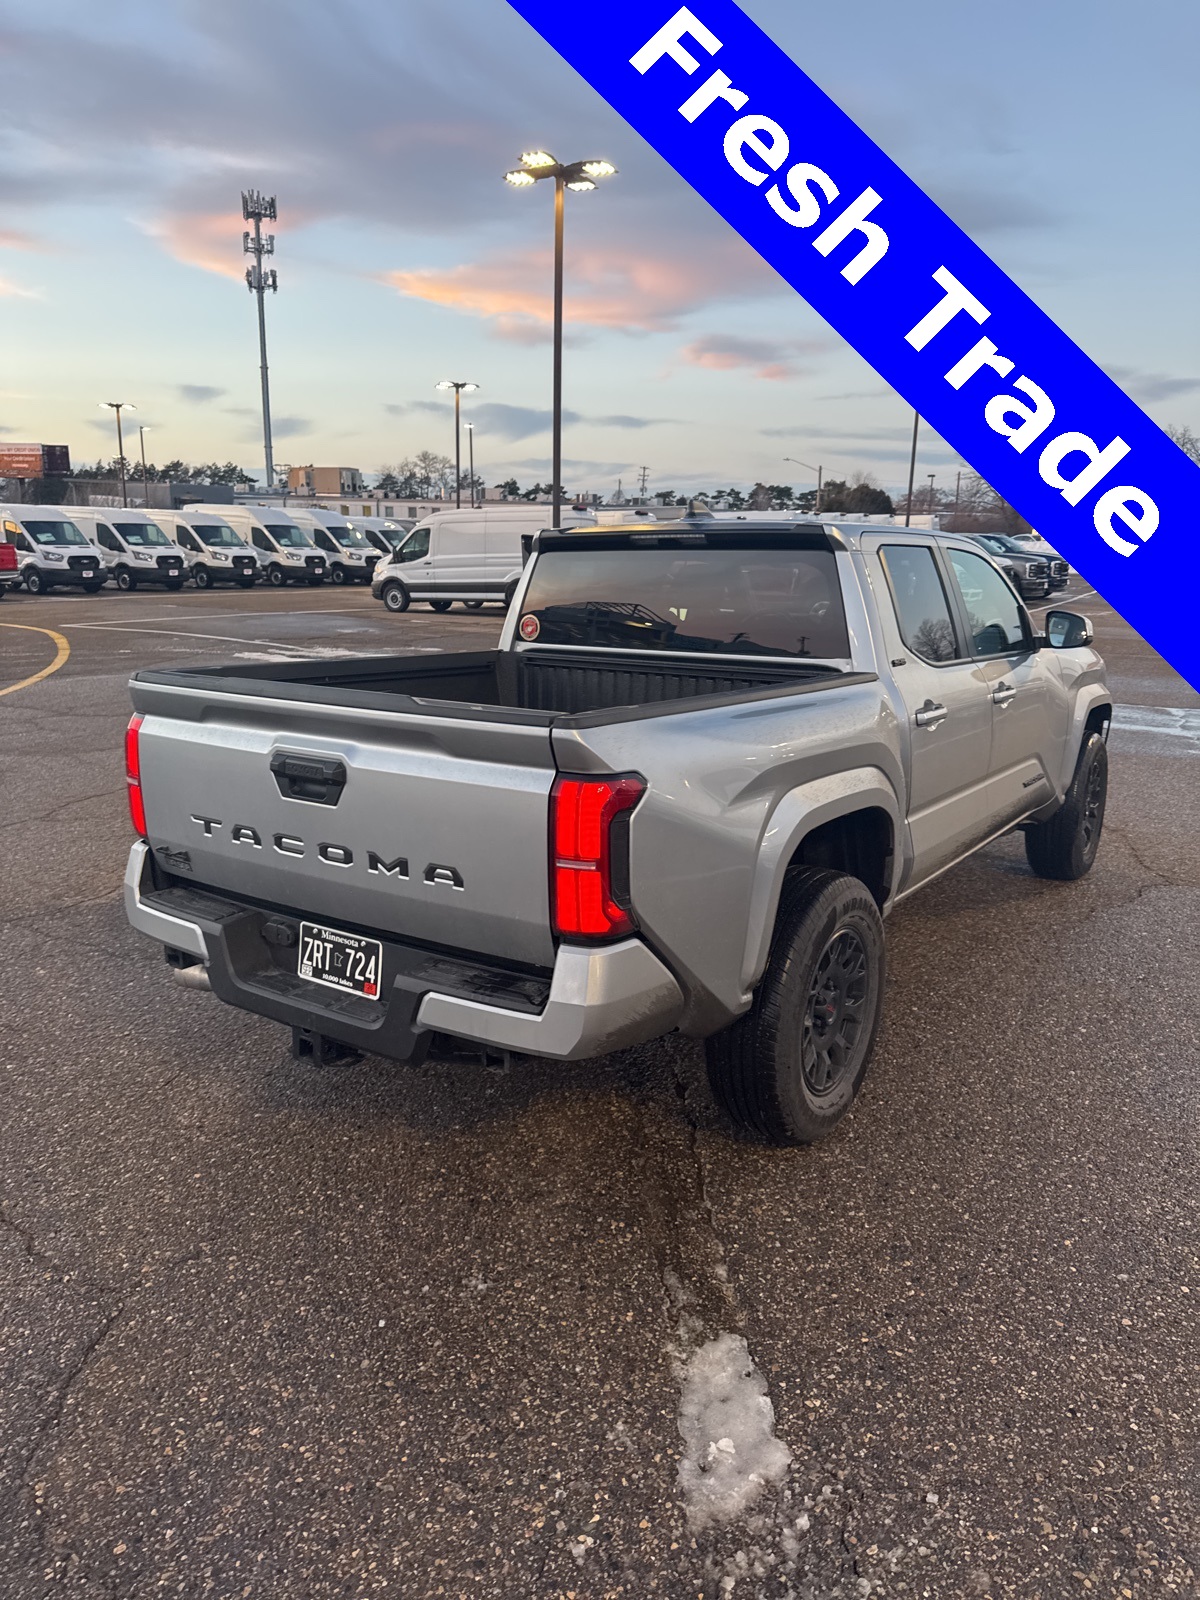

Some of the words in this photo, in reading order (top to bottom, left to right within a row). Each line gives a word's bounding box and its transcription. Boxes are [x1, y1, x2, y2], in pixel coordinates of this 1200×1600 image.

[190, 814, 464, 891] TACOMA
[321, 929, 359, 948] Minnesota
[303, 937, 334, 971] ZRT
[345, 948, 376, 984] 724
[322, 973, 339, 983] 10,000
[339, 978, 354, 987] lakes
